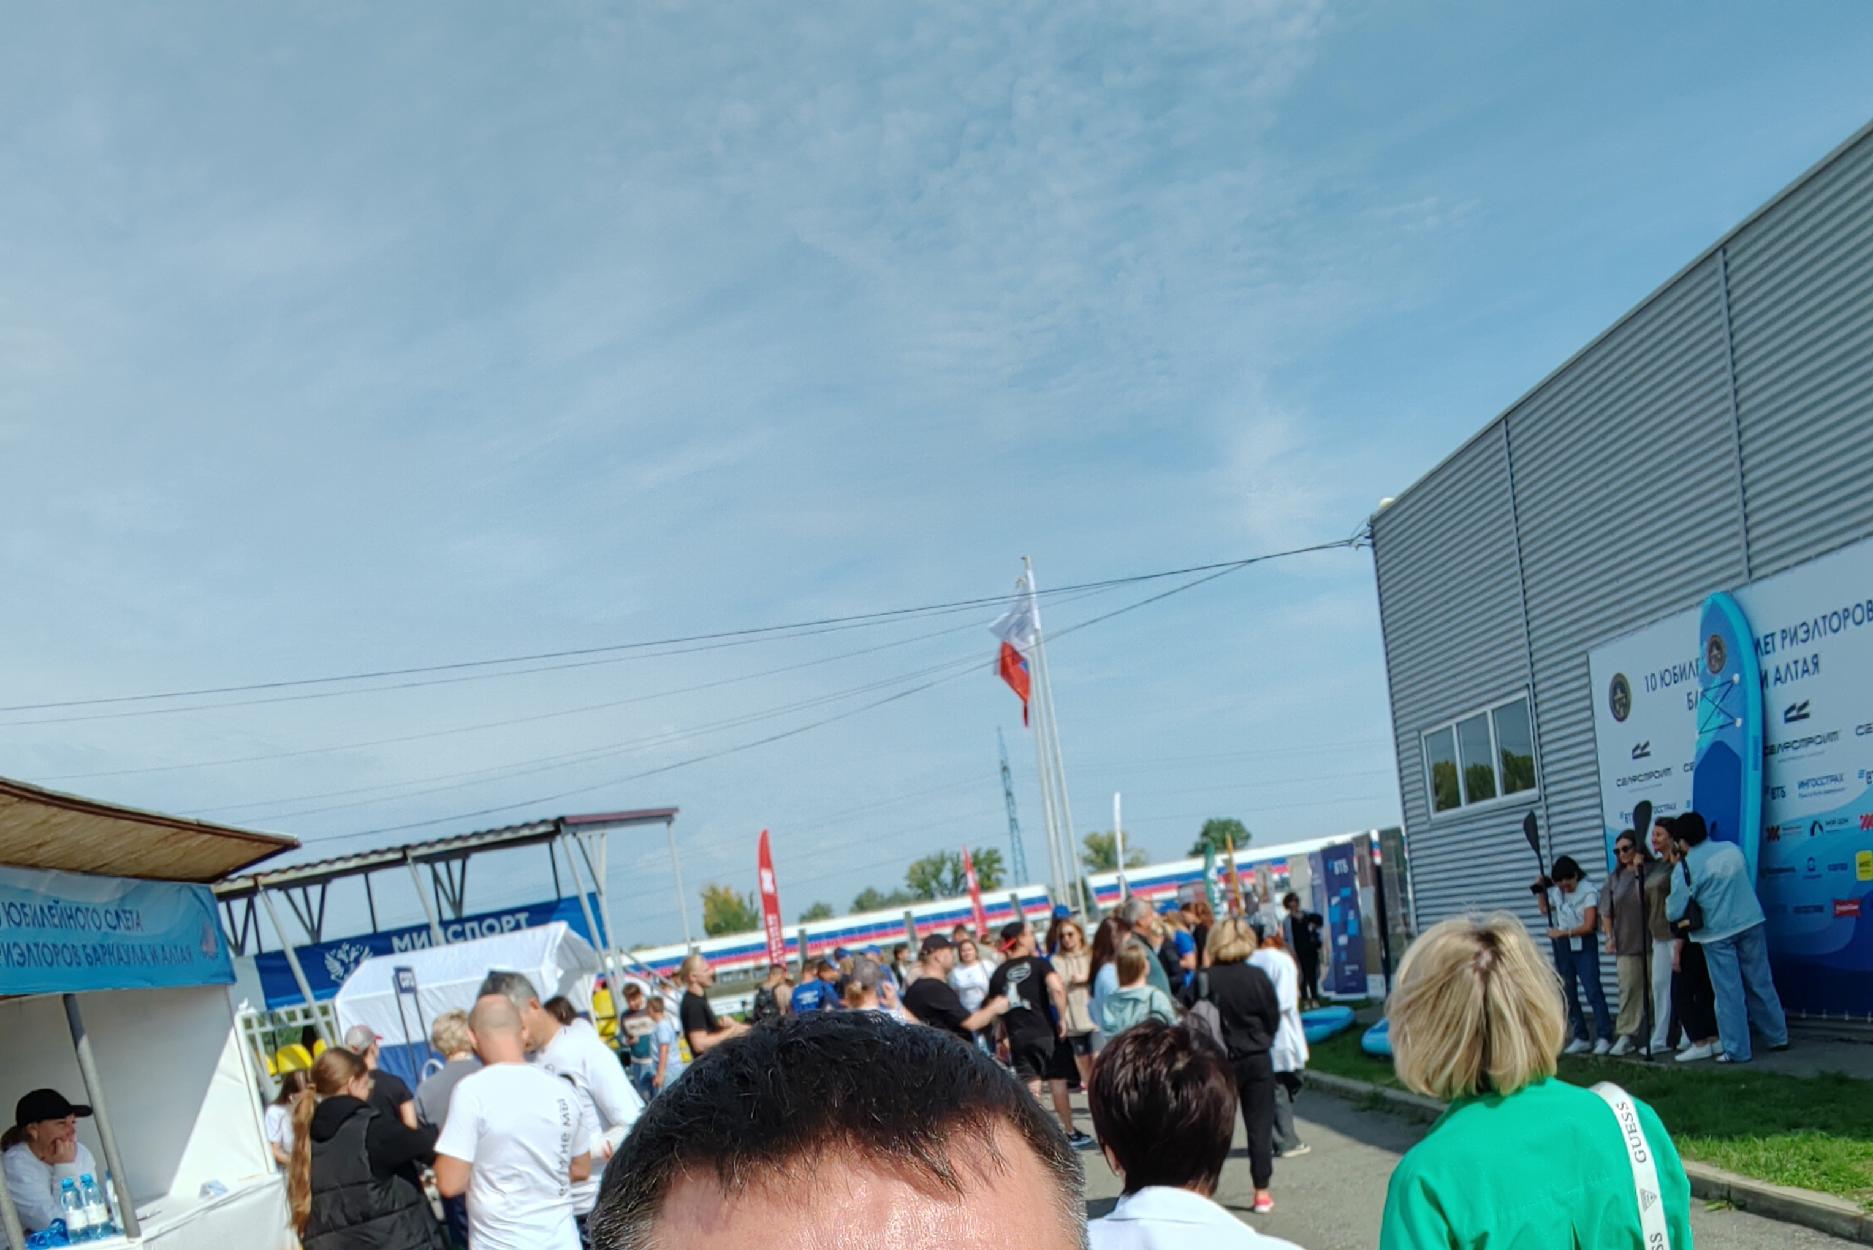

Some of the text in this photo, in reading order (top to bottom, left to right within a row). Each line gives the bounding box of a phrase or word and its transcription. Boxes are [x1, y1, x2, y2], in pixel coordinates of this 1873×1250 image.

[1645, 672, 1657, 693] 10
[1781, 599, 1873, 651] РИЭЛТОРОВ
[1773, 653, 1820, 687] АЛТАЯ
[1, 899, 144, 932] ЮБИЛЕЙНОГО СЛЕТА
[0, 942, 81, 968] ИЭЛТОРОВ
[1616, 1101, 1647, 1163] GUESS
